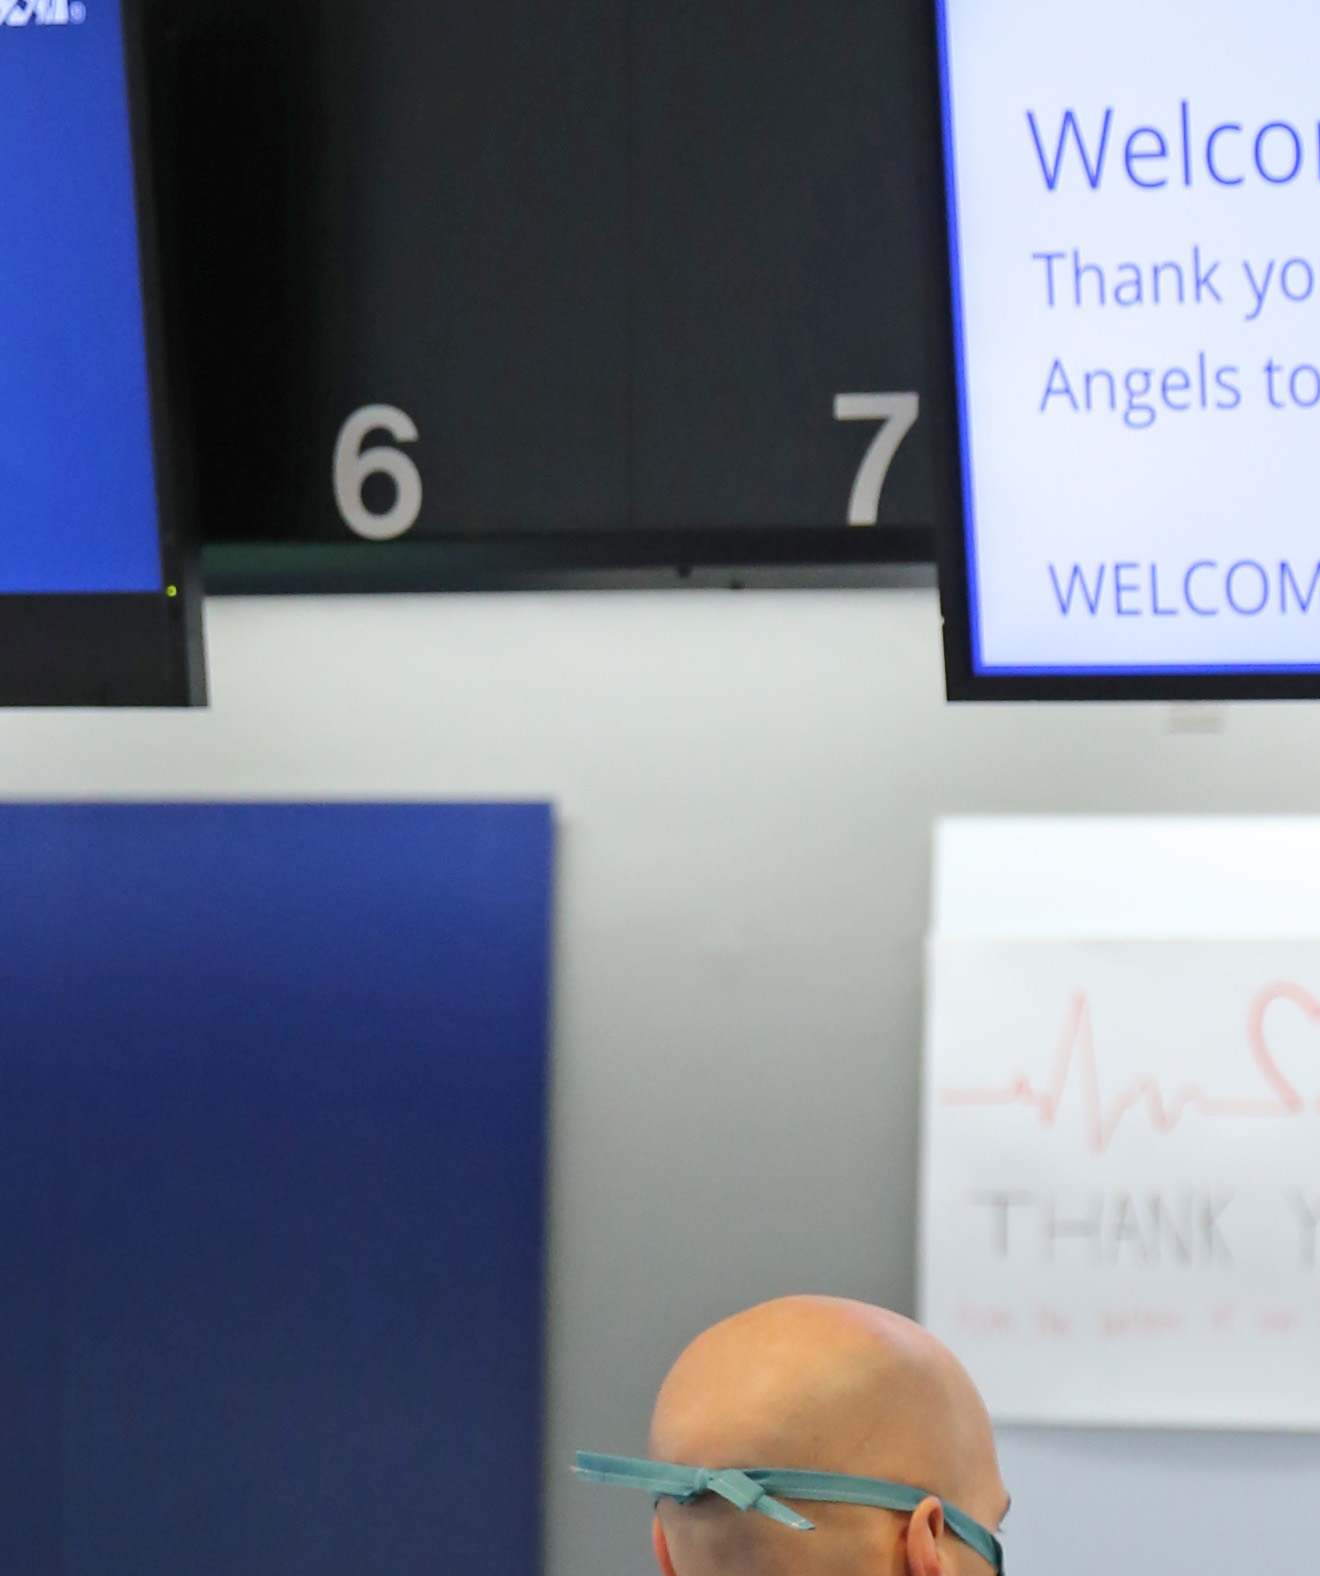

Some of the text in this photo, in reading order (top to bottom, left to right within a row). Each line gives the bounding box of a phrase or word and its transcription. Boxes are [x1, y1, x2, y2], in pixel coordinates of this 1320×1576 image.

[1032, 245, 1224, 308] Thank
[1038, 351, 1243, 430] Angels
[332, 402, 423, 542] 6
[833, 390, 920, 527] 7
[970, 1187, 1236, 1271] THANK
